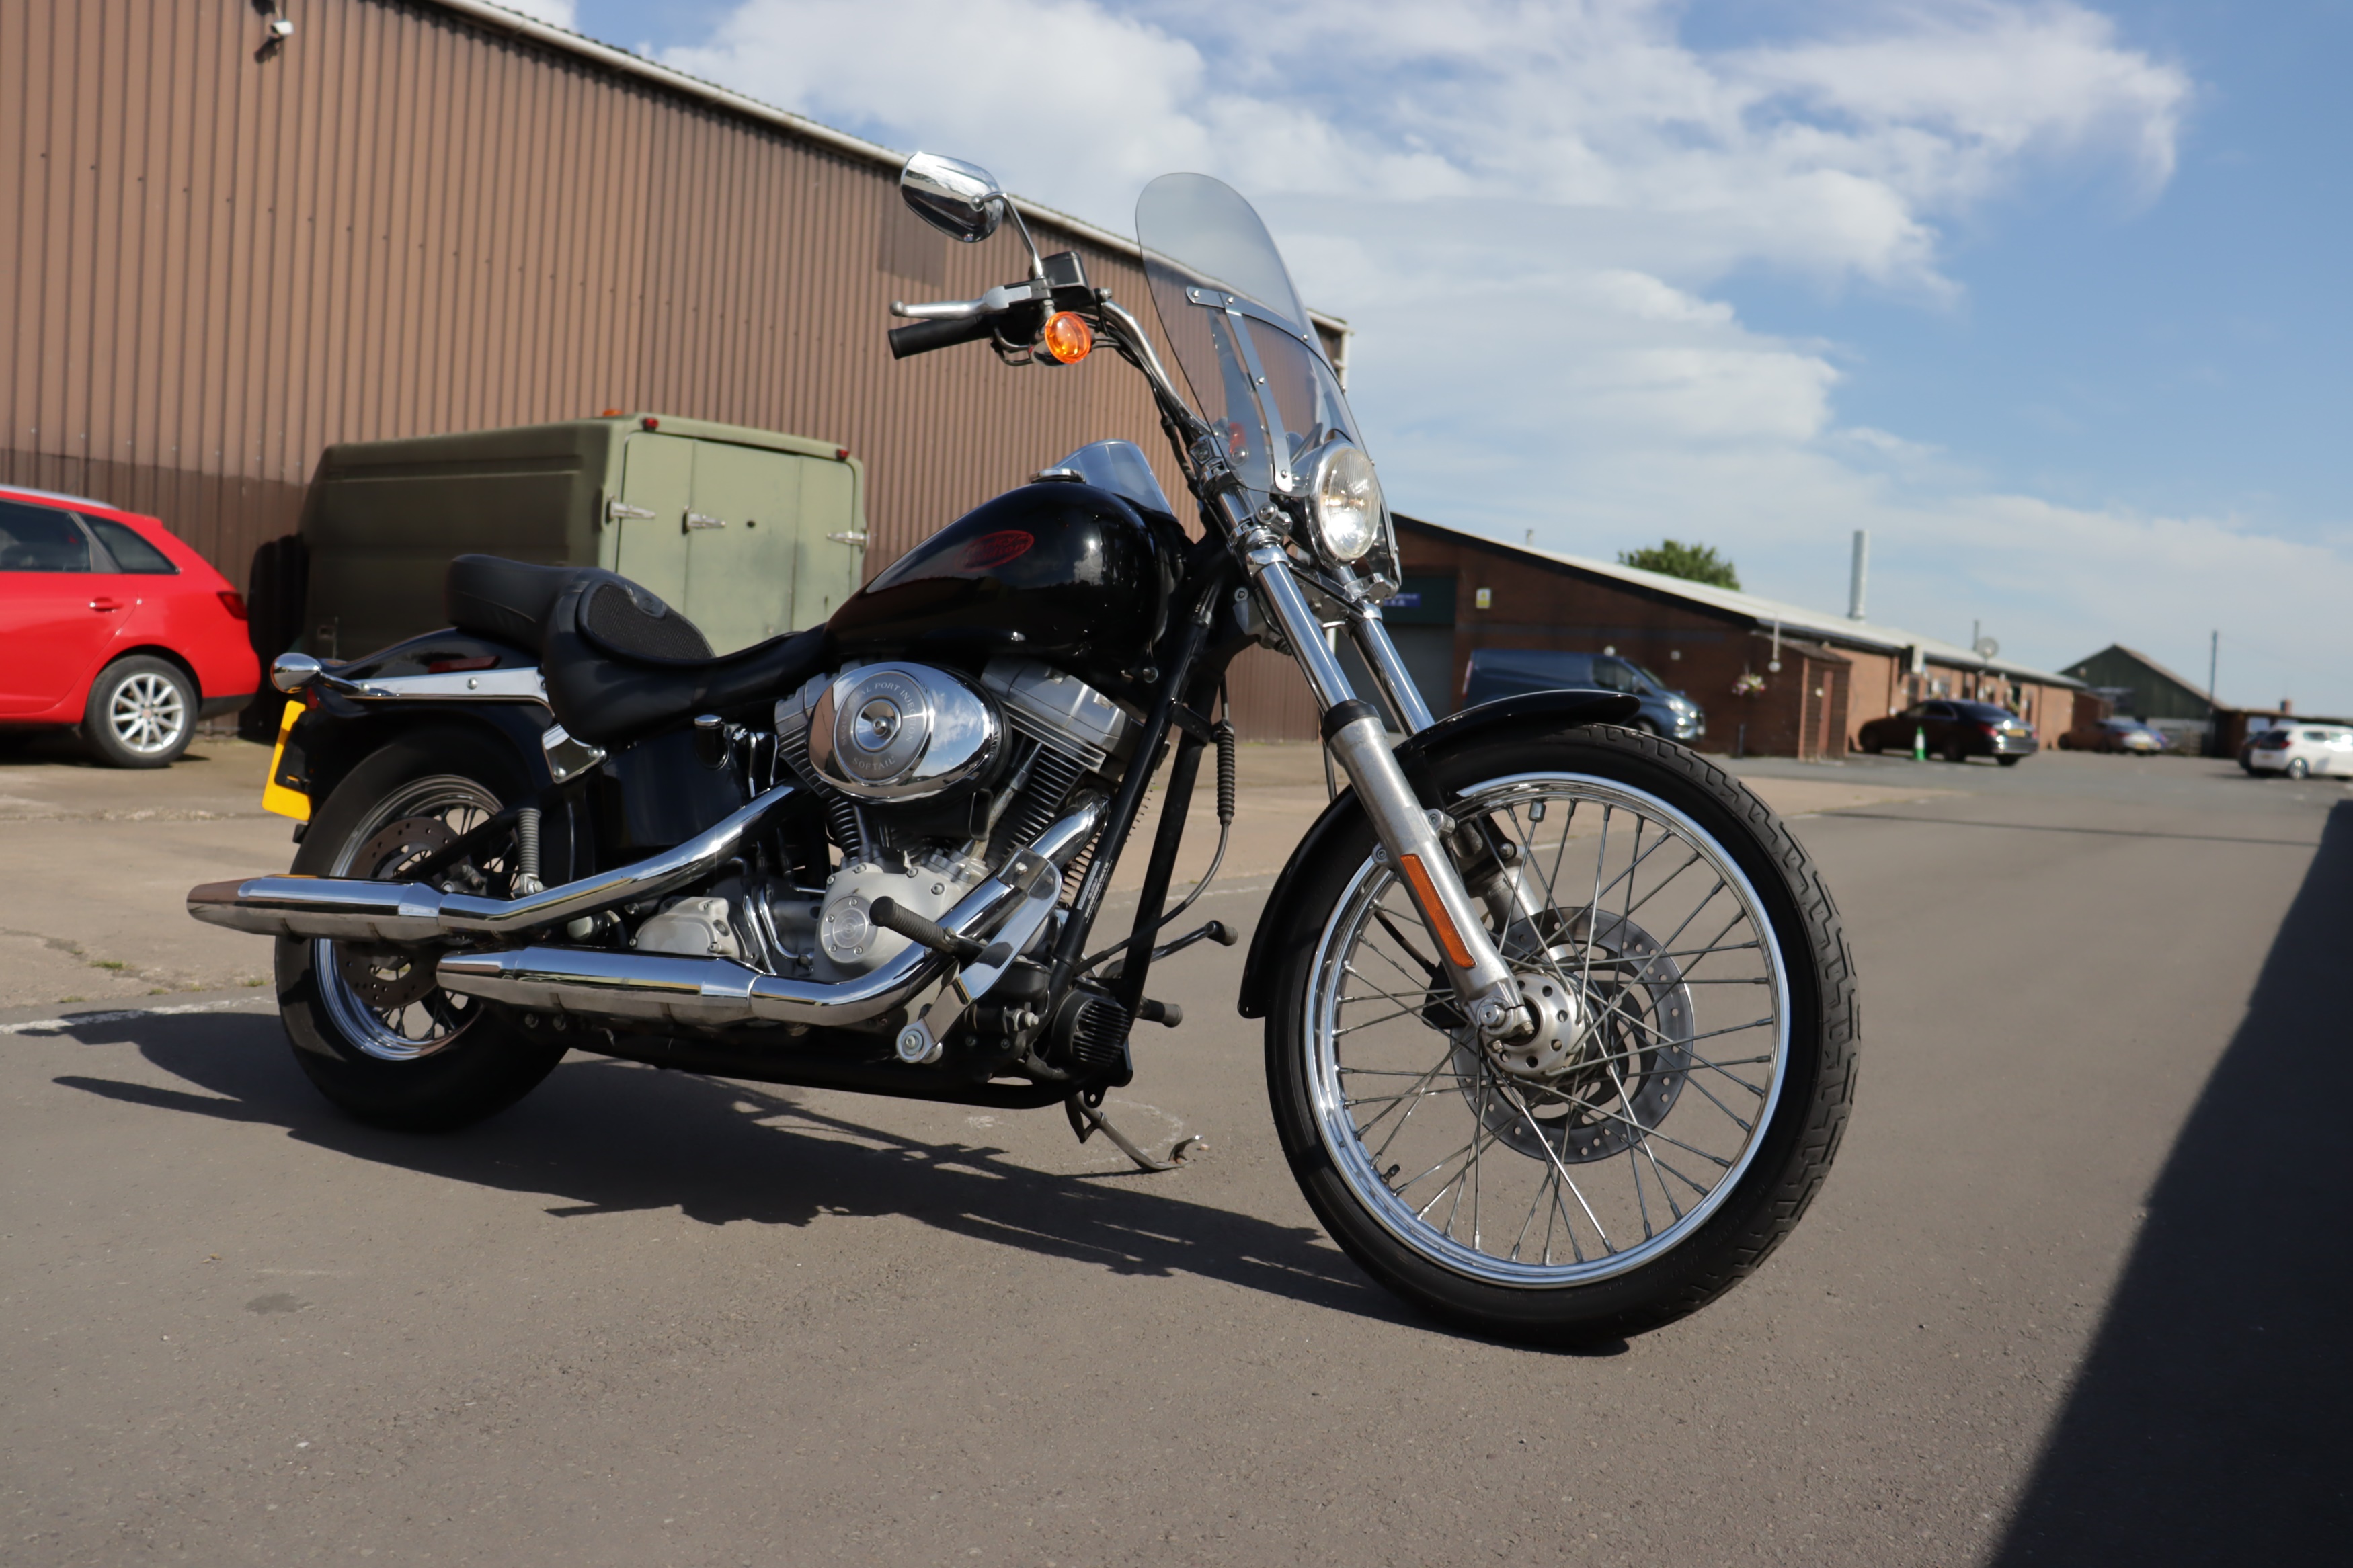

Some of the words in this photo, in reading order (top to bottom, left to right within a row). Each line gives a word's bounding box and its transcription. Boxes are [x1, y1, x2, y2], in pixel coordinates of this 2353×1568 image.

[874, 681, 901, 692] PORT
[900, 689, 917, 743] INJECTION
[852, 757, 896, 771] SOFTAIL
